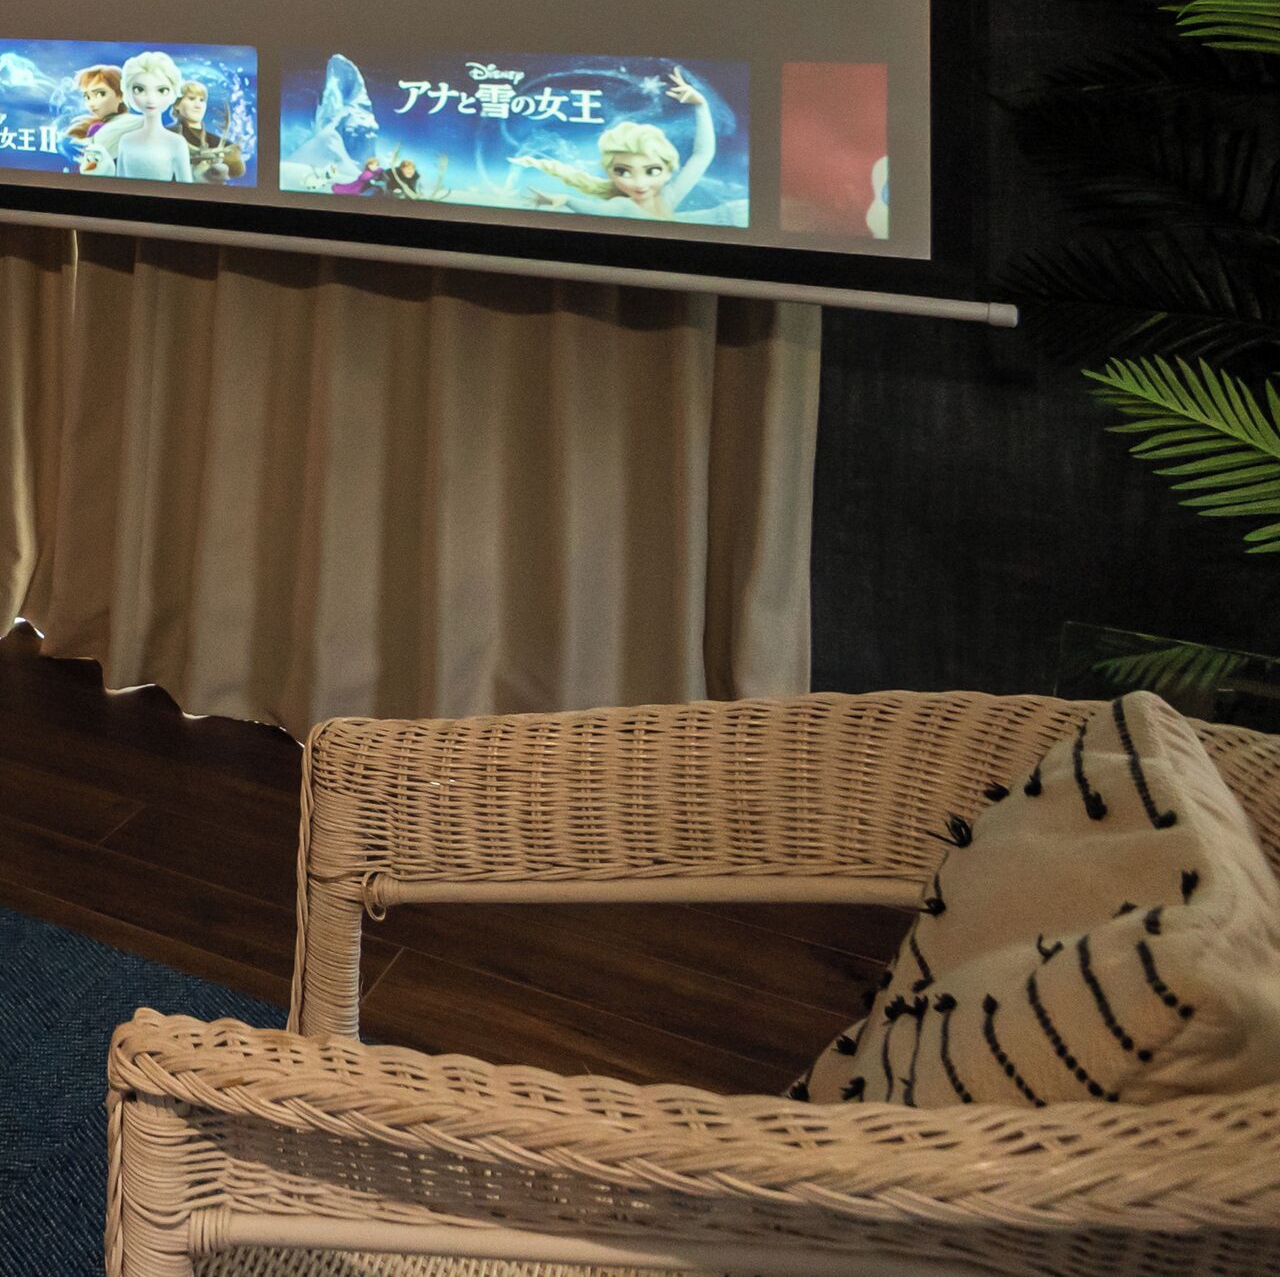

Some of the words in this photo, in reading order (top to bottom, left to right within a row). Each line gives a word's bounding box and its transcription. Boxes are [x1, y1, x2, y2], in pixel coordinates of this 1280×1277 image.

[465, 62, 525, 84] Disney
[393, 80, 605, 124] アナと雪の女王
